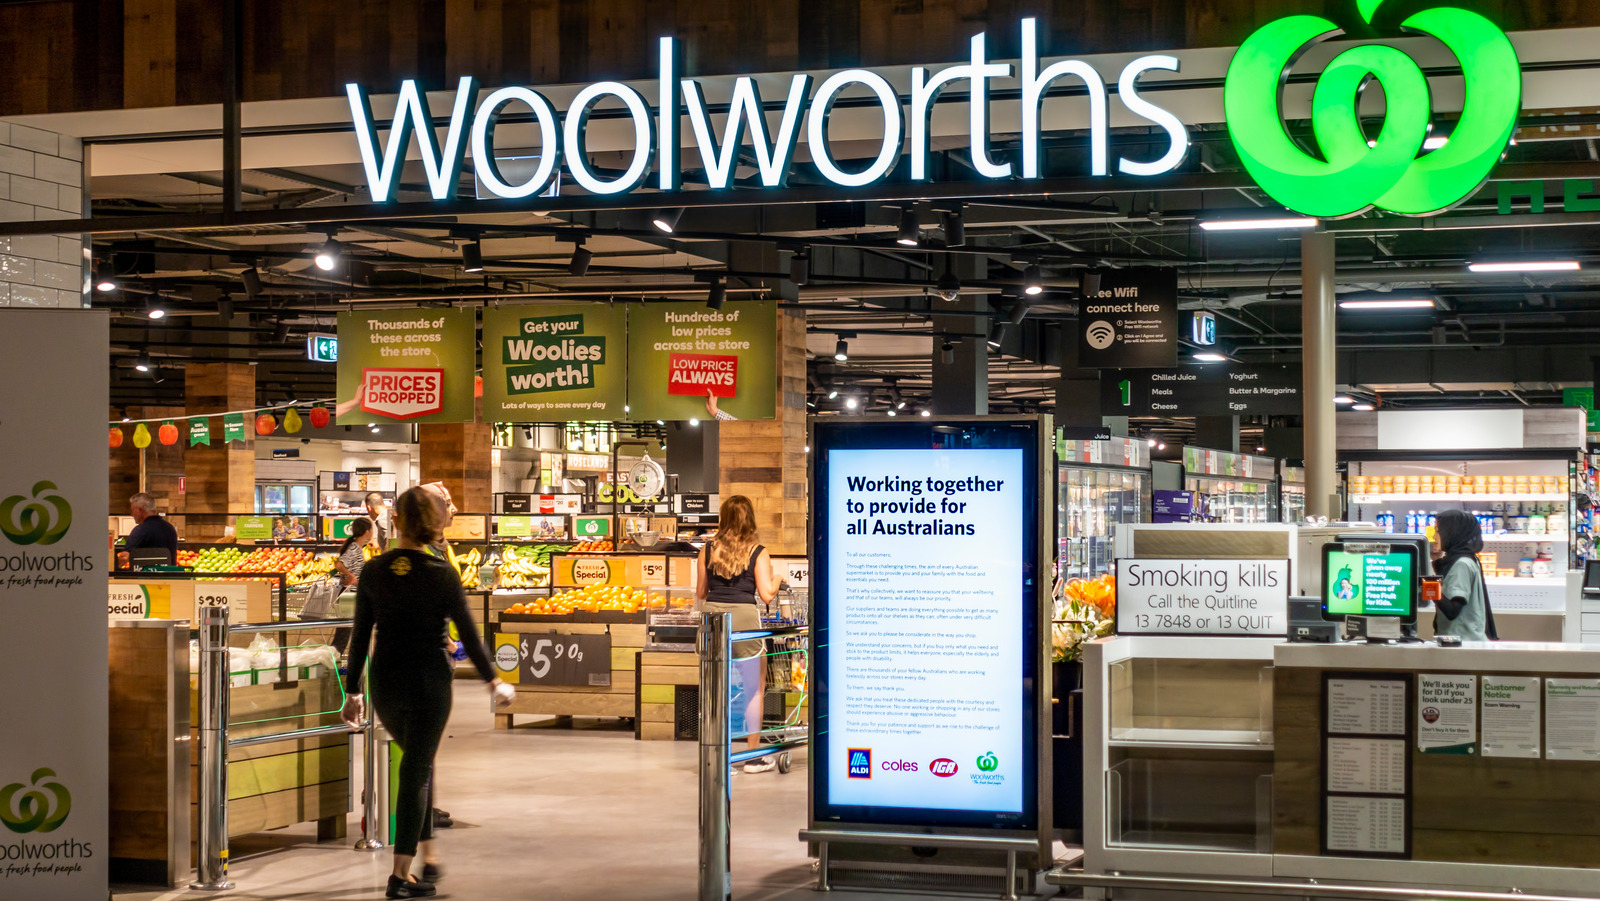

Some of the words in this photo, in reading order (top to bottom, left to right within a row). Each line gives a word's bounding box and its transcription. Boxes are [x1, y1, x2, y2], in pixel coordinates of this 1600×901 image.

[346, 17, 1190, 203] Woolworths
[1086, 288, 1112, 298] ee
[1113, 287, 1138, 298] Wifi
[1086, 303, 1133, 313] connect
[1134, 302, 1160, 312] here
[664, 311, 724, 323] Hundreds
[725, 310, 740, 321] of
[367, 318, 430, 330] Thousands
[432, 317, 445, 328] of
[524, 321, 549, 333] Get
[550, 320, 580, 335] your
[671, 325, 694, 336] low
[695, 325, 732, 339] prices
[370, 333, 402, 344] these
[404, 333, 442, 343] across
[507, 339, 602, 361] Woolies
[653, 341, 693, 351] across
[695, 339, 716, 350] the
[718, 340, 750, 350] store
[380, 346, 400, 357] the
[401, 346, 432, 356] store
[672, 359, 699, 370] LOW
[700, 360, 735, 371] PRICE
[510, 363, 589, 391] worth!
[670, 370, 735, 386] ALWAYS
[1151, 373, 1176, 382] Chilled
[1177, 373, 1197, 381] Juice
[1229, 372, 1258, 382] Yoghurt
[369, 375, 437, 392] PRICES
[368, 391, 436, 404] DROPPED
[1118, 379, 1131, 406] 1
[1151, 388, 1173, 396] Meals
[1229, 387, 1252, 395] Butter
[1260, 387, 1297, 396] Margarine
[518, 401, 527, 409] of
[526, 403, 545, 411] ways
[572, 402, 592, 410] every
[592, 401, 606, 410] day
[1151, 402, 1178, 410] Cheese
[1229, 402, 1247, 411] Eggs
[568, 456, 609, 469] ROSELANDS
[847, 475, 922, 496] Working
[926, 475, 1004, 496] together
[846, 499, 864, 514] to
[869, 497, 936, 517] provide
[941, 497, 966, 514] for
[846, 519, 867, 535] all
[872, 519, 976, 536] Australians
[0, 551, 93, 571] oolworths
[1365, 557, 1387, 565] We've
[7, 574, 31, 589] fresh
[33, 574, 55, 589] food
[55, 576, 83, 588] people
[575, 571, 606, 581] Special
[1128, 563, 1228, 593] Smoking
[1238, 563, 1278, 588] kills
[1365, 592, 1381, 600] Free
[1147, 594, 1174, 610] Call
[1177, 594, 1200, 610] the
[1204, 593, 1258, 612] Quitline
[107, 603, 143, 615] pecial
[1134, 614, 1149, 629] 13
[1155, 614, 1191, 629] 7848
[1196, 618, 1212, 629] or
[1217, 615, 1232, 629] 13
[1237, 615, 1273, 631] QUIT
[1422, 680, 1440, 689] We'll
[1441, 681, 1454, 689] ask
[1484, 684, 1526, 692] Customer
[1422, 688, 1434, 696] for
[1484, 691, 1511, 699] Notice
[1422, 695, 1439, 704] look
[850, 766, 869, 774] ALDI
[881, 759, 918, 772] coles
[931, 761, 956, 774] IGA
[970, 773, 1005, 781] Woolworths
[0, 837, 93, 860] olworths
[6, 863, 30, 878] fresh
[32, 862, 54, 877] food
[54, 862, 82, 876] people
